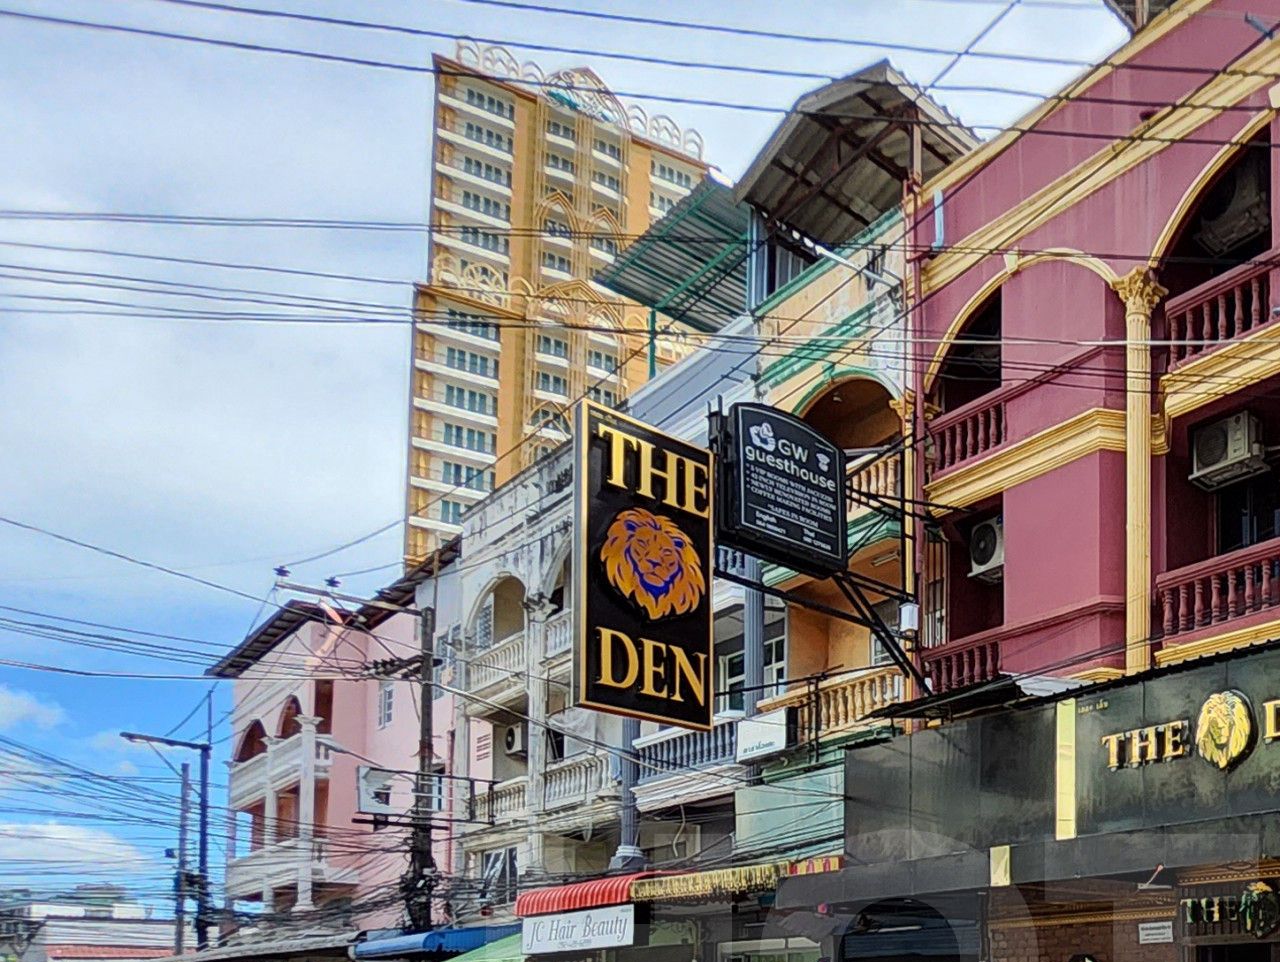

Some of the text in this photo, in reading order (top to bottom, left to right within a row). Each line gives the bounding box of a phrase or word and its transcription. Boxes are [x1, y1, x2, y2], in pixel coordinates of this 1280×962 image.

[598, 422, 710, 519] THE
[744, 445, 837, 492] guesthouse
[778, 438, 808, 463] GW
[595, 626, 708, 707] DEN
[1102, 719, 1189, 772] THE
[527, 912, 628, 951] JC Hair Beauty
[1180, 895, 1238, 924] THE
